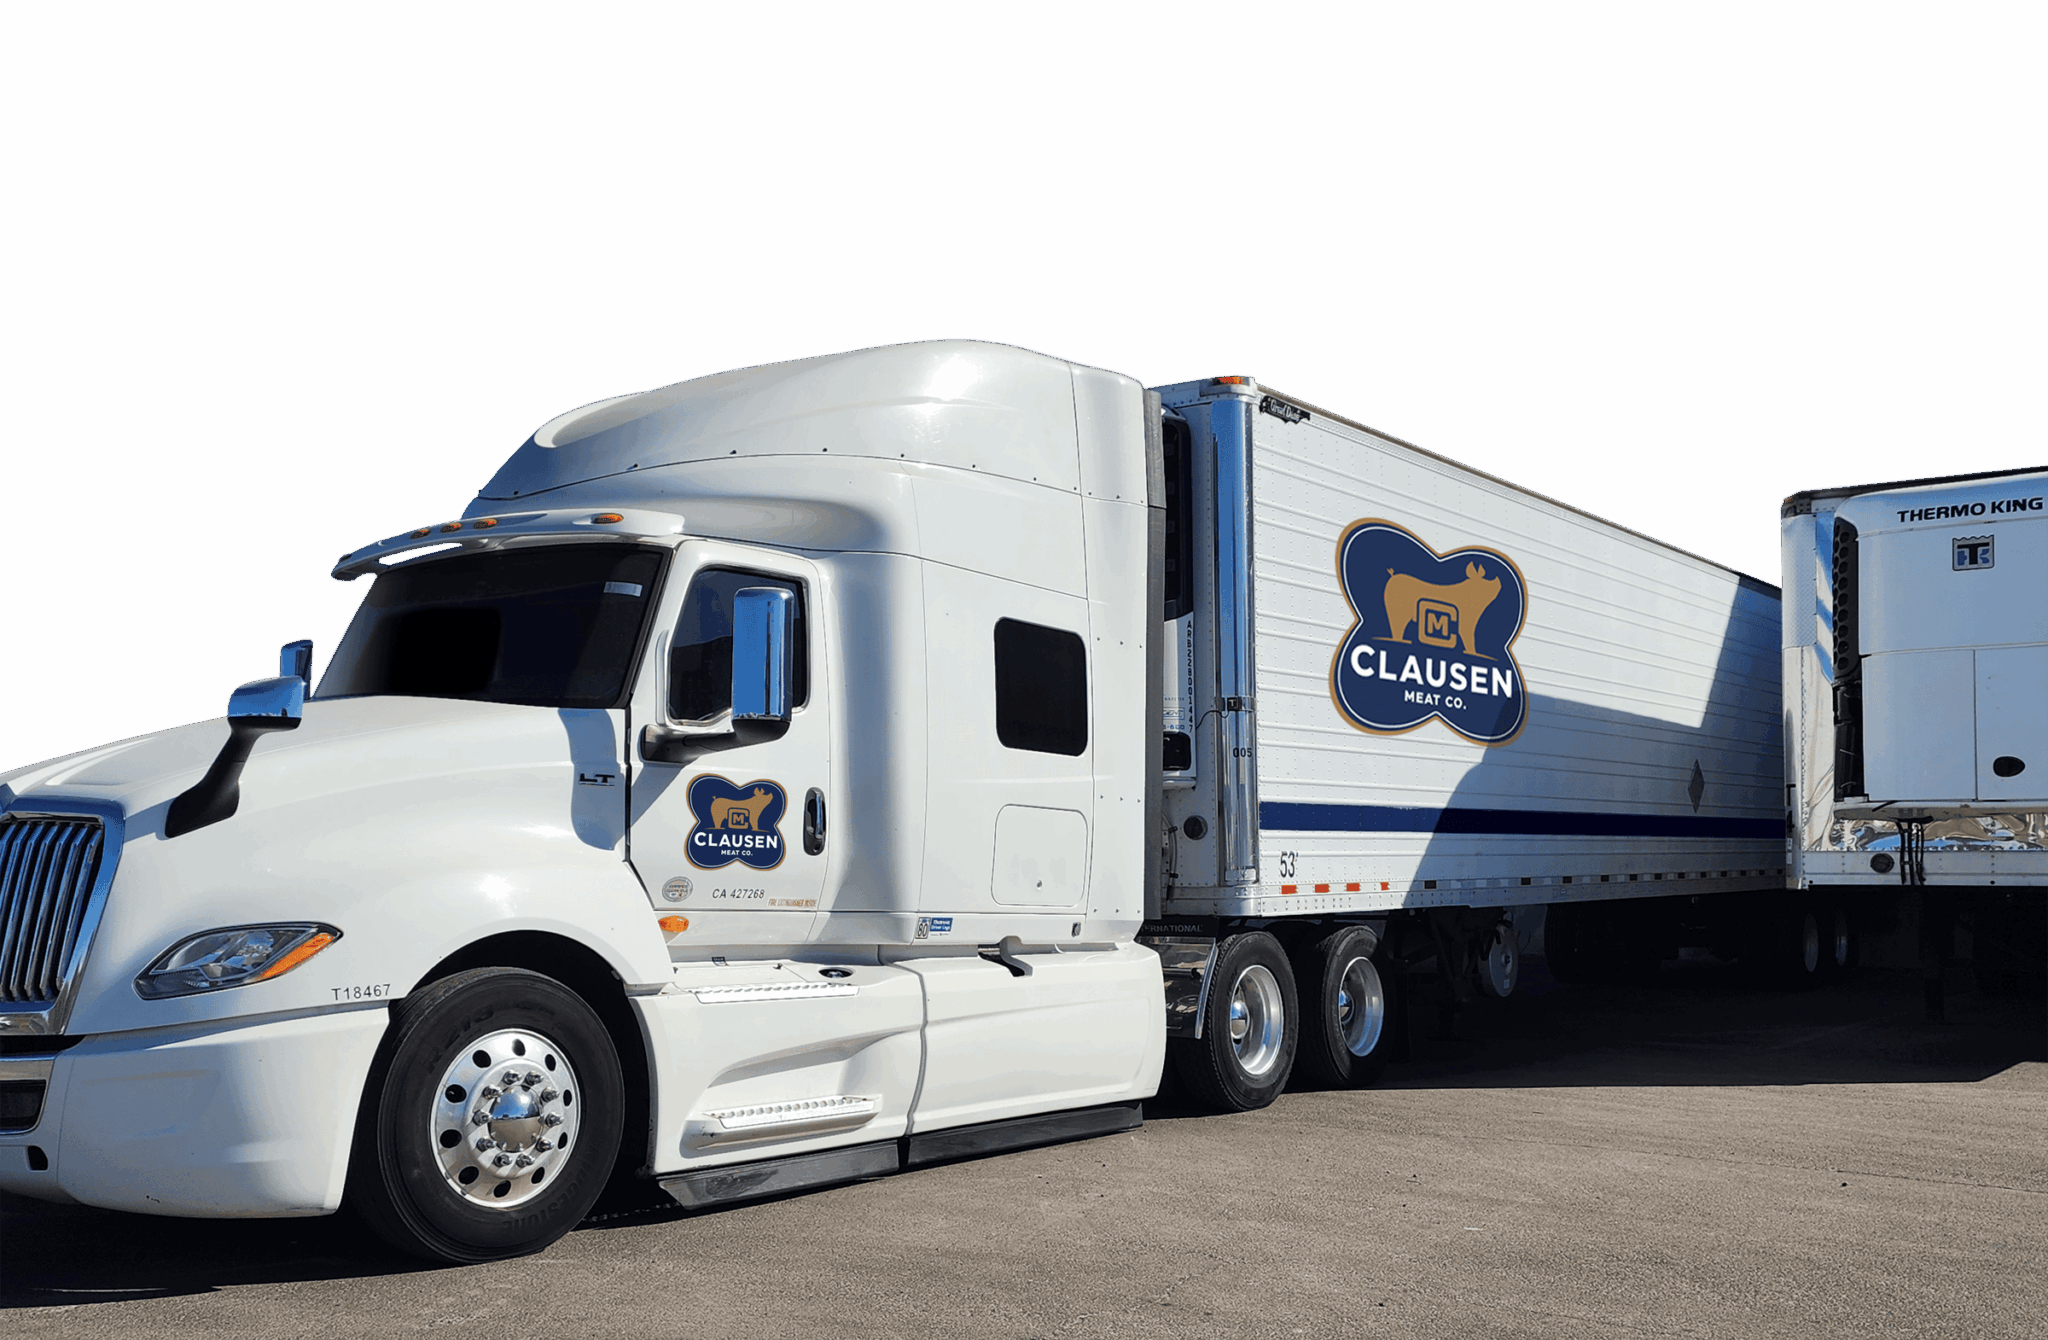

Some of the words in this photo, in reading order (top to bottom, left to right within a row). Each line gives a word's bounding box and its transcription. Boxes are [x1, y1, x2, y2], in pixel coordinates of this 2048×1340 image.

[1897, 503, 1986, 523] THERMO
[1991, 497, 2043, 514] KING
[1350, 644, 1512, 698] CLAUSEN
[1404, 690, 1441, 706] MEAT
[1445, 696, 1467, 710] CO.
[579, 773, 615, 786] LT
[694, 832, 778, 849] CLAUSEN
[712, 888, 727, 899] CA
[730, 888, 765, 899] 427268
[330, 983, 391, 1001] T18467
